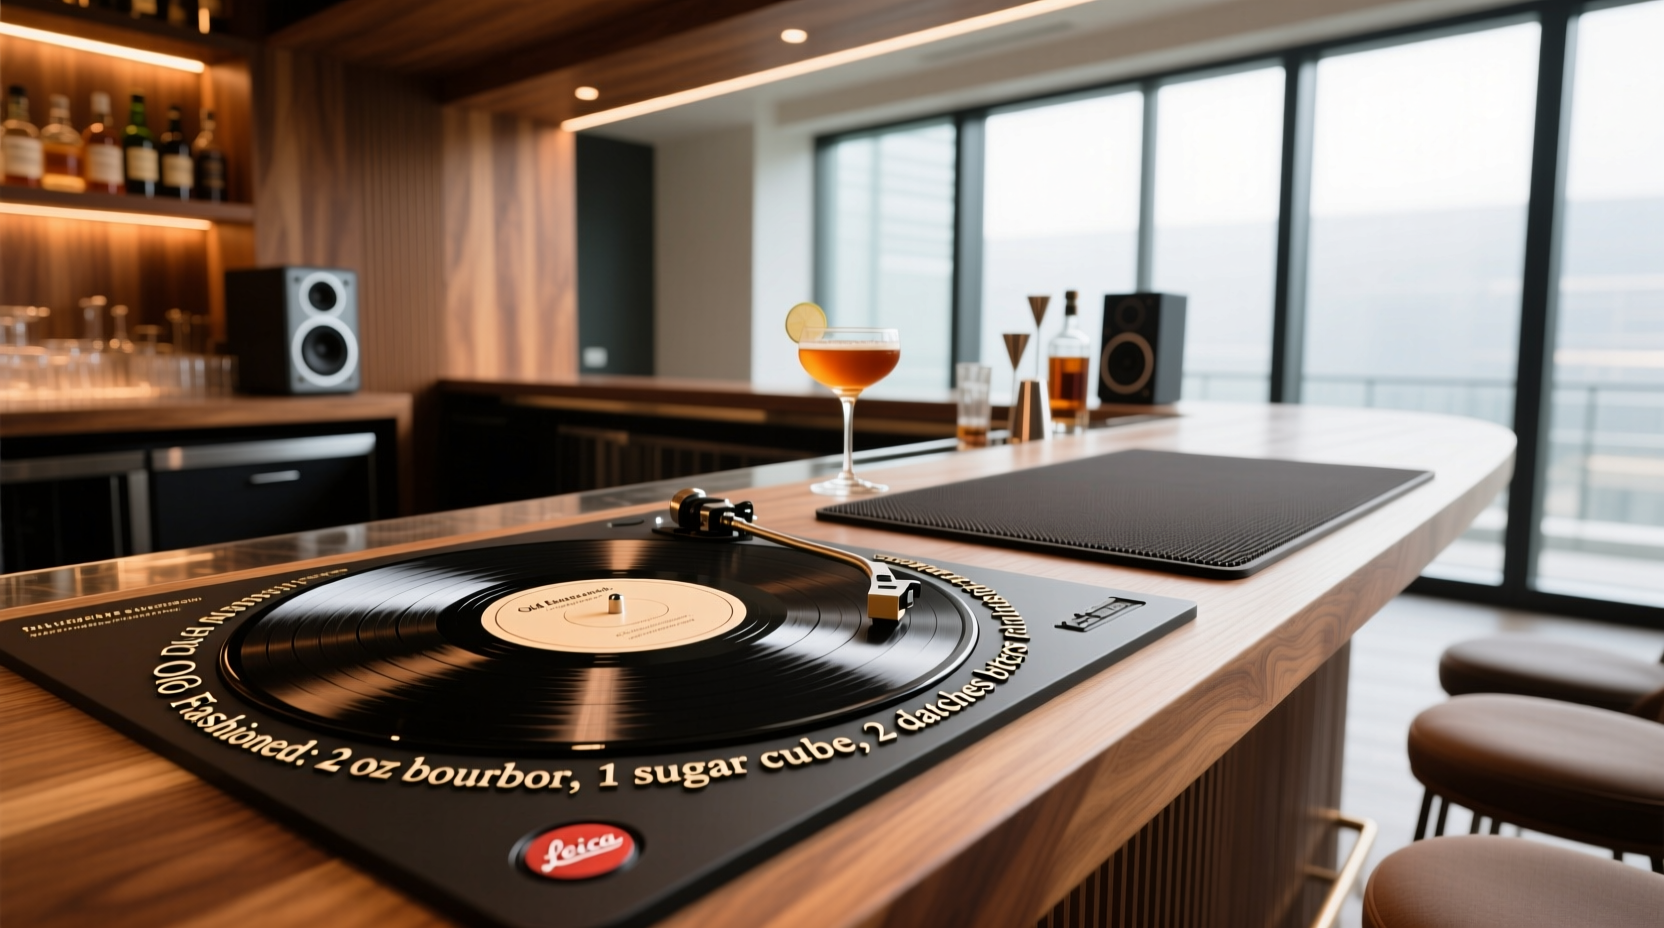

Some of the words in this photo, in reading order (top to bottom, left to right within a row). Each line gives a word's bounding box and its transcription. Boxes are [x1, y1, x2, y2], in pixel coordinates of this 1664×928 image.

[170, 691, 319, 766] Fashioned:
[314, 748, 352, 772] 2
[350, 757, 401, 779] oz
[402, 756, 580, 794] bourbor,
[599, 763, 618, 787] 1
[634, 754, 748, 789] sugar
[760, 737, 871, 769] cube,
[863, 721, 898, 742] 2
[541, 833, 624, 873] Leica
